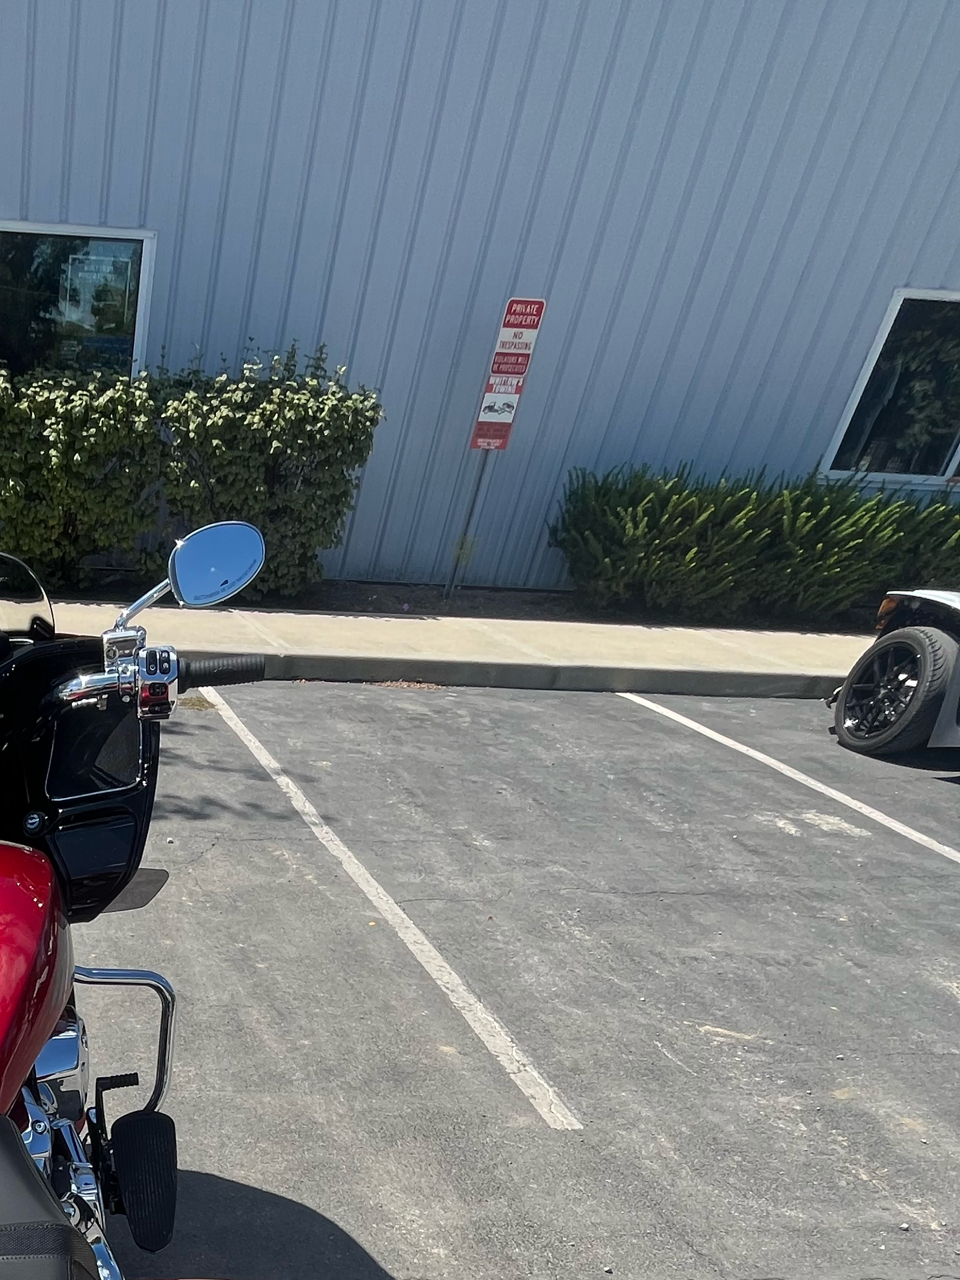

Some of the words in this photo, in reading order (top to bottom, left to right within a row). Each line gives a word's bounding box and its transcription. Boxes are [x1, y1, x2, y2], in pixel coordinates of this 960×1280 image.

[511, 303, 539, 315] PRIVATE
[505, 314, 540, 325] PROPERTY
[512, 331, 524, 340] NO
[498, 341, 533, 351] TRESPASSING
[491, 384, 517, 394] TOWING
